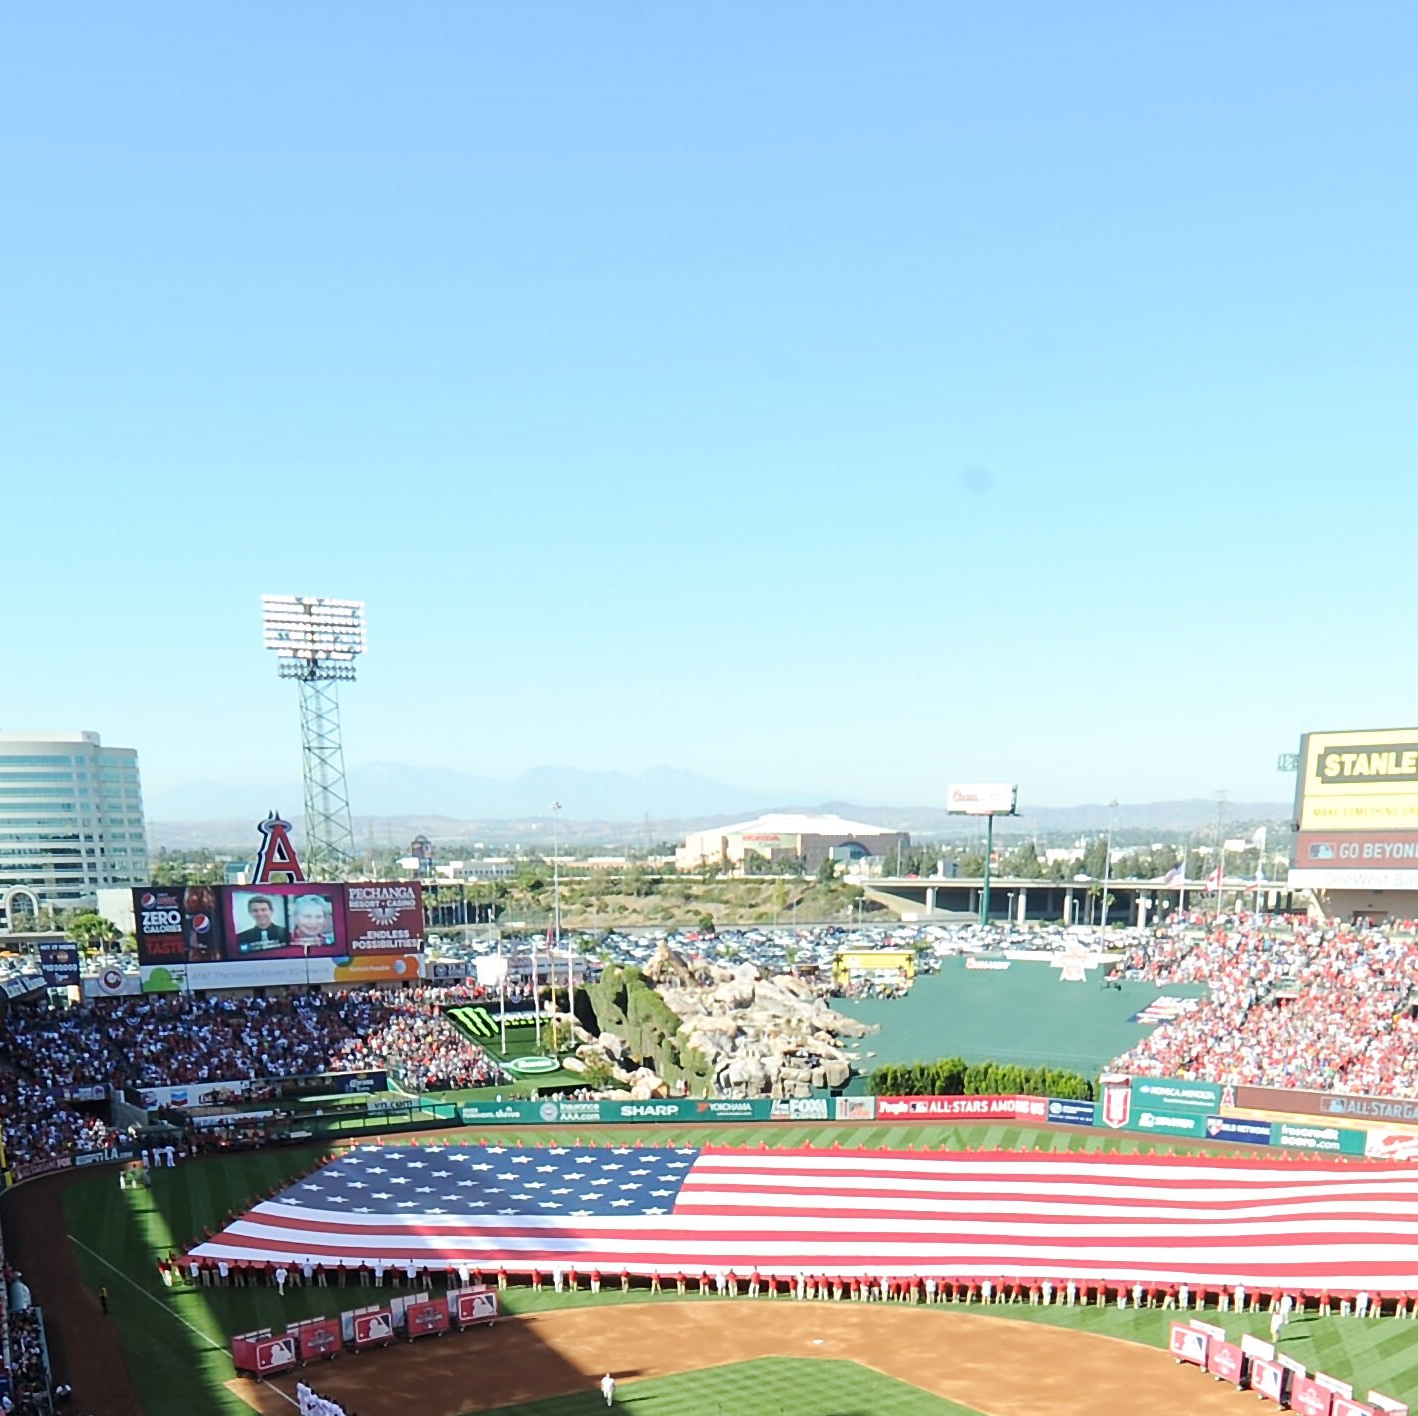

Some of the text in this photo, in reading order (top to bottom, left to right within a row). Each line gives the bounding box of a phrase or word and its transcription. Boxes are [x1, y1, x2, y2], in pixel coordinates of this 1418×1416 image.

[1338, 843, 1360, 859] GO
[1324, 873, 1394, 886] OneWest
[348, 887, 416, 900] PECHANGA
[141, 911, 181, 925] ZERO
[621, 1105, 678, 1116] SHARP
[709, 1103, 752, 1111] YOKOHAMA
[879, 1101, 909, 1116] People
[990, 1100, 1030, 1114] AMONG
[1030, 1102, 1045, 1116] US
[560, 1112, 600, 1121] AAA.com
